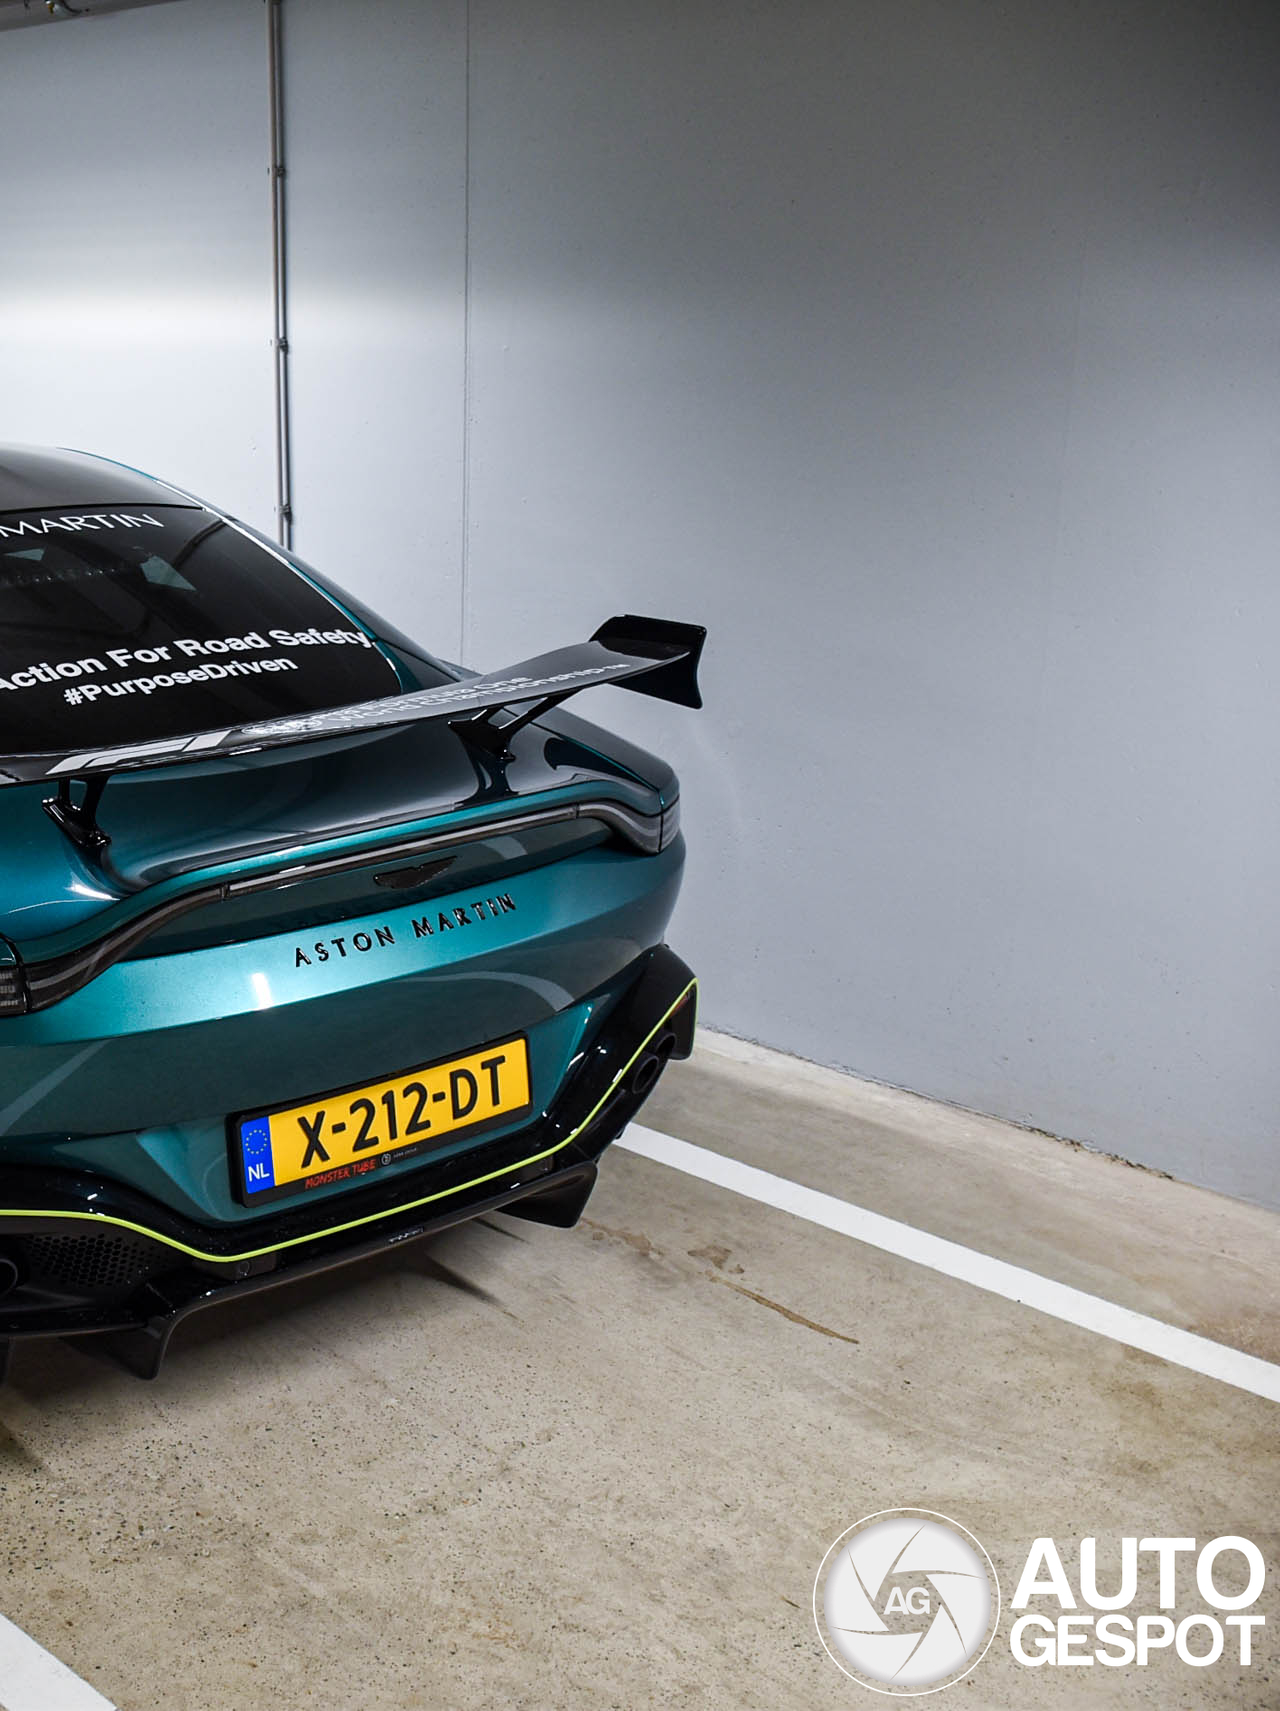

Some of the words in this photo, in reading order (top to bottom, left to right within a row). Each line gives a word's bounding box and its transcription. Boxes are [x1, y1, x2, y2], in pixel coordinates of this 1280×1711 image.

[105, 645, 172, 667] For
[173, 631, 270, 657] Road
[269, 628, 373, 648] Safety
[63, 657, 298, 705] #PurposeDriven
[295, 926, 395, 968] ASTON
[411, 893, 517, 939] MARTIN
[297, 1055, 506, 1169] X-212-DT
[248, 1162, 270, 1182] NL
[304, 1168, 352, 1189] MONSTER
[353, 1159, 376, 1176] TUBE
